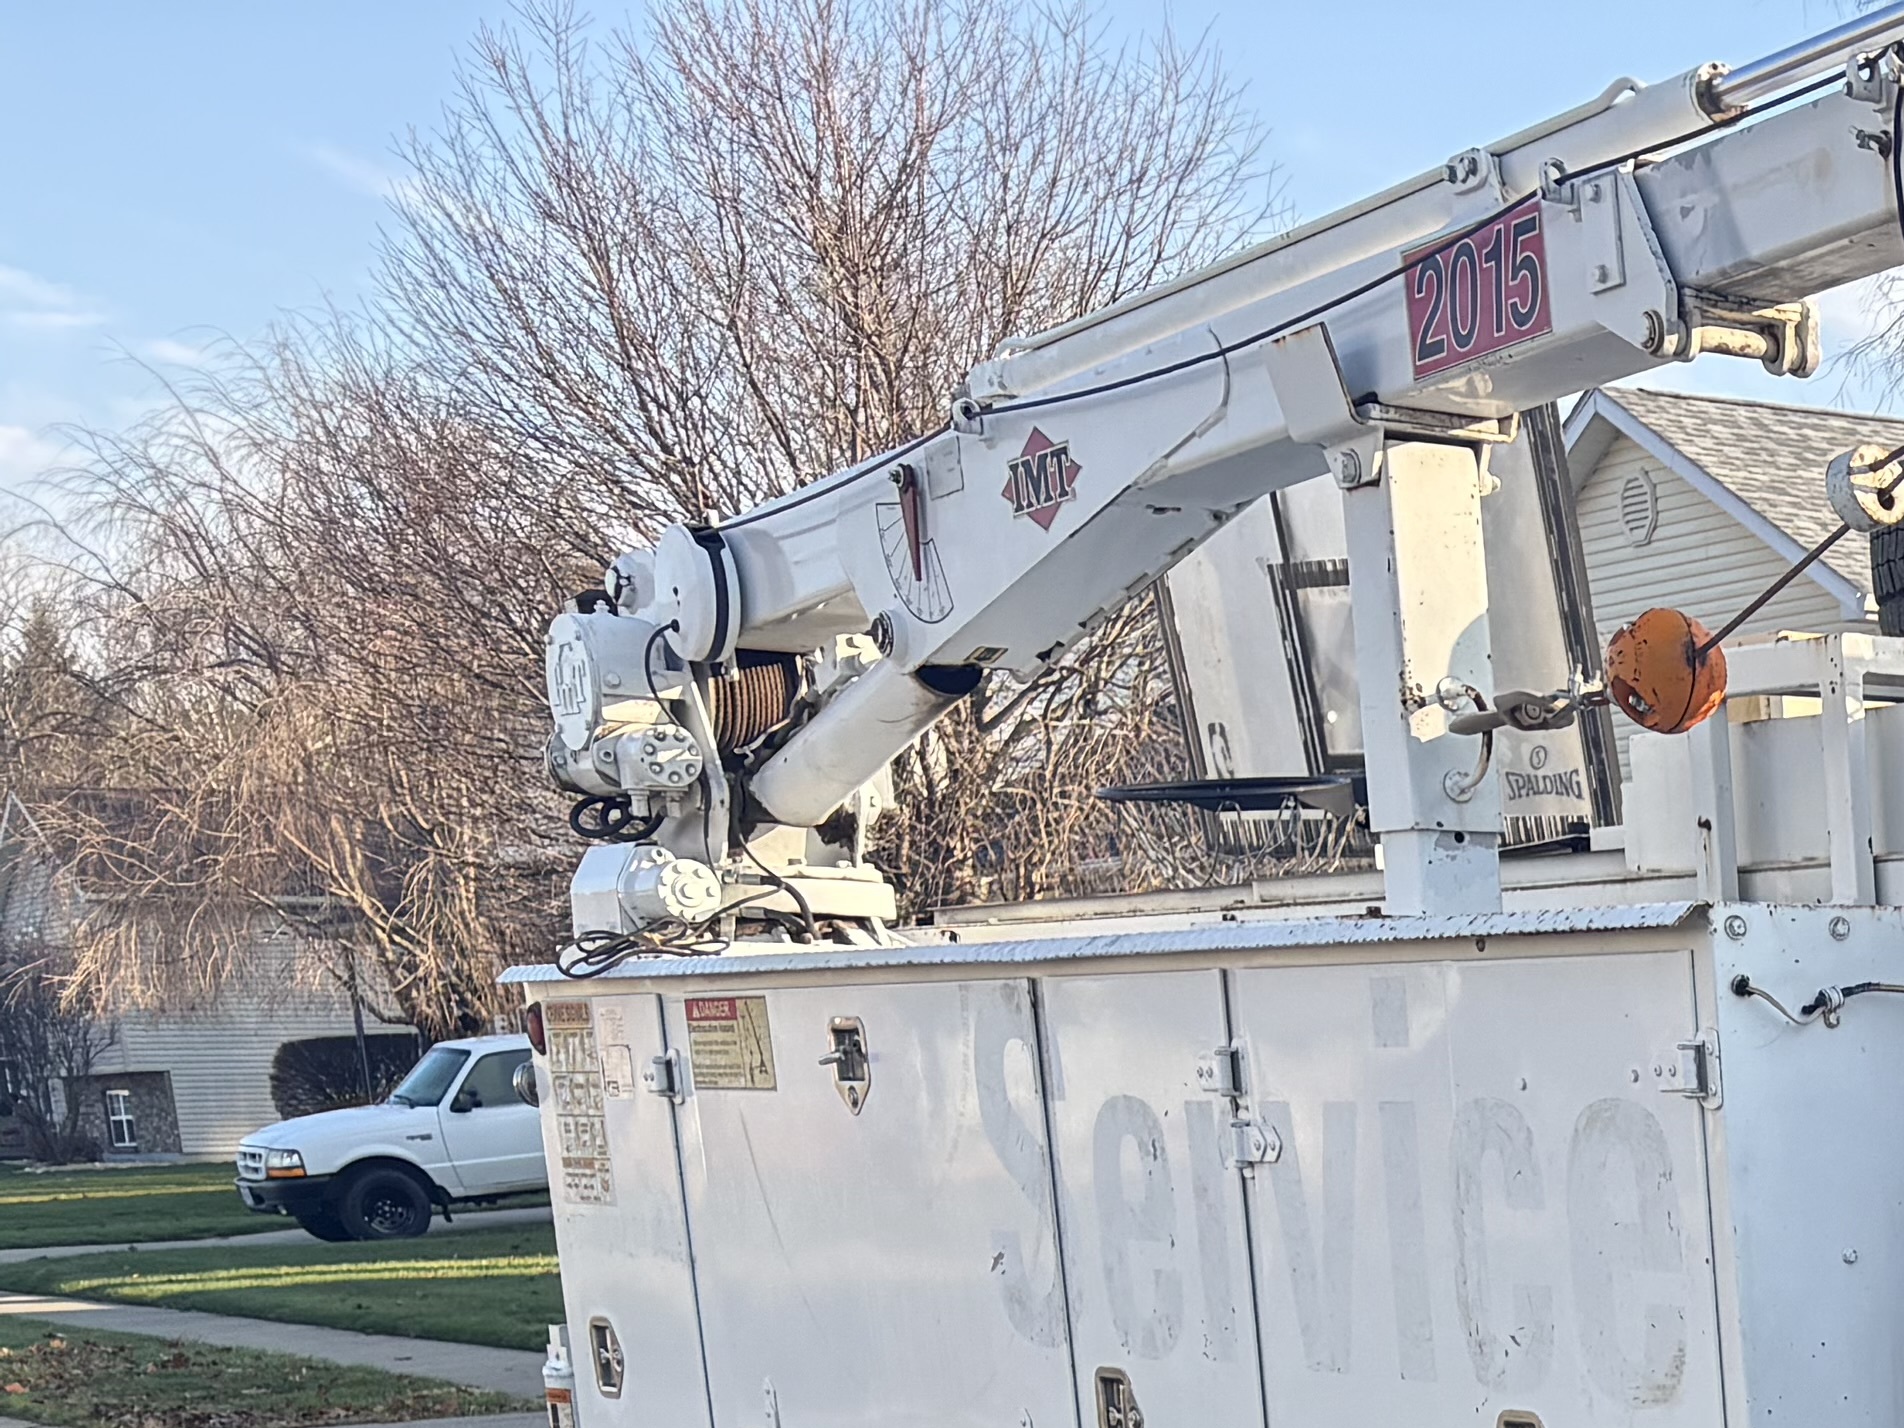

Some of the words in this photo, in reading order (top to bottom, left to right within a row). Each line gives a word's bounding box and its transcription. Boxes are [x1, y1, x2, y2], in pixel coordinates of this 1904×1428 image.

[1414, 211, 1542, 366] 2015
[1007, 440, 1071, 517] IMT
[1504, 768, 1584, 801] SPALDING
[973, 977, 1690, 1408] Service
